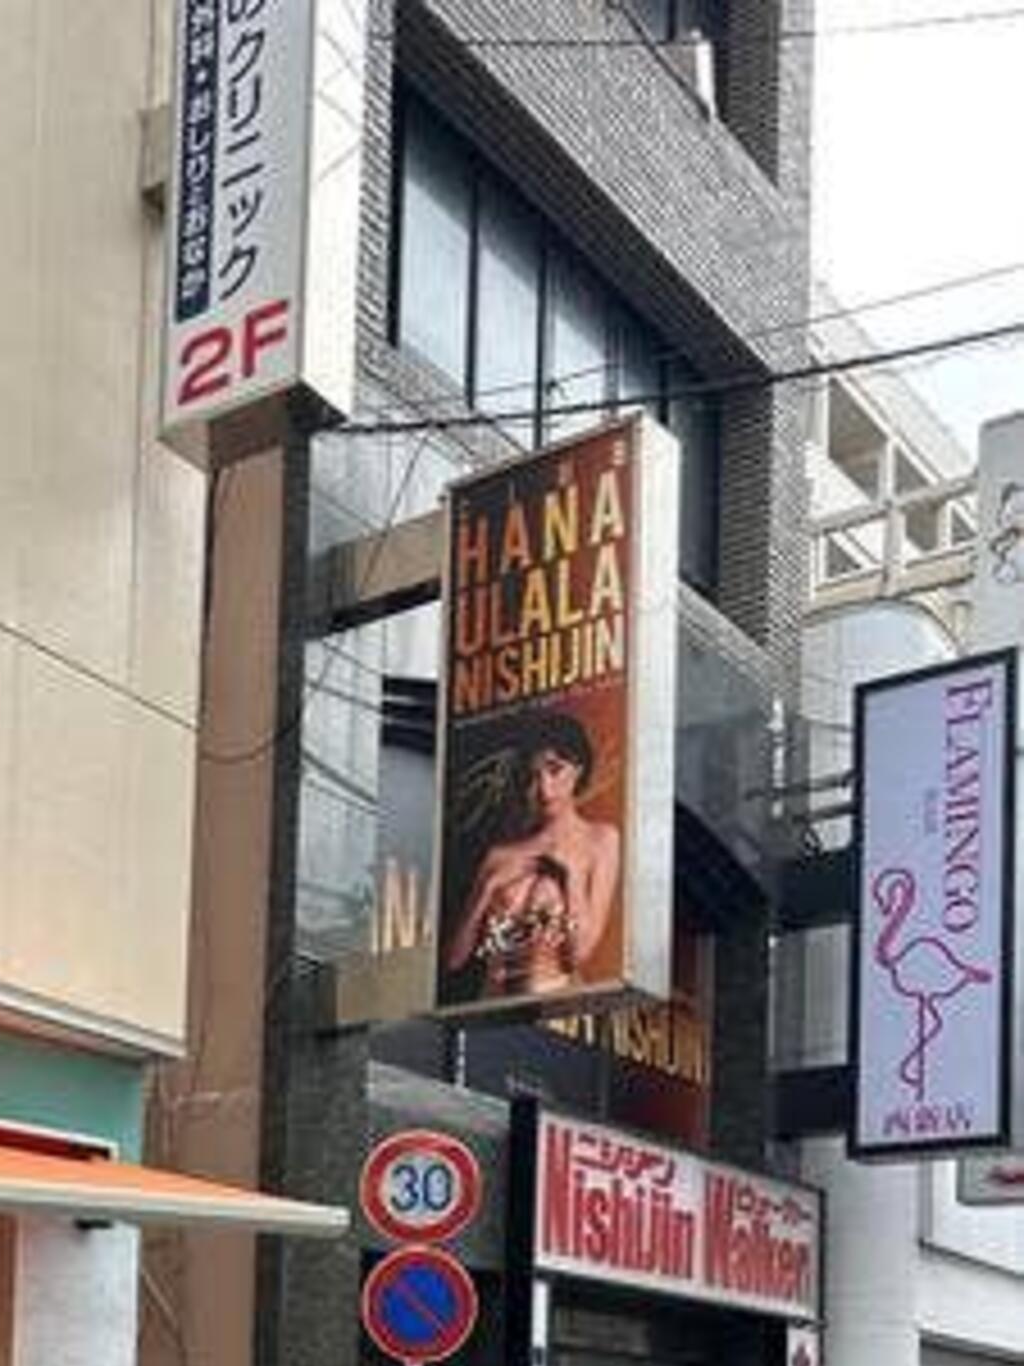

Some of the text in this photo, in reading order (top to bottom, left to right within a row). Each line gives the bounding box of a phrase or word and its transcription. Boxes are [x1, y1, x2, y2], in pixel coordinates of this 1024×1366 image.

[177, 300, 289, 406] 2F
[458, 468, 625, 590] HANA
[458, 544, 625, 656] ULALA
[454, 614, 626, 714] NISHIJIN
[946, 677, 993, 935] FLAMINGO
[390, 1163, 453, 1213] 30
